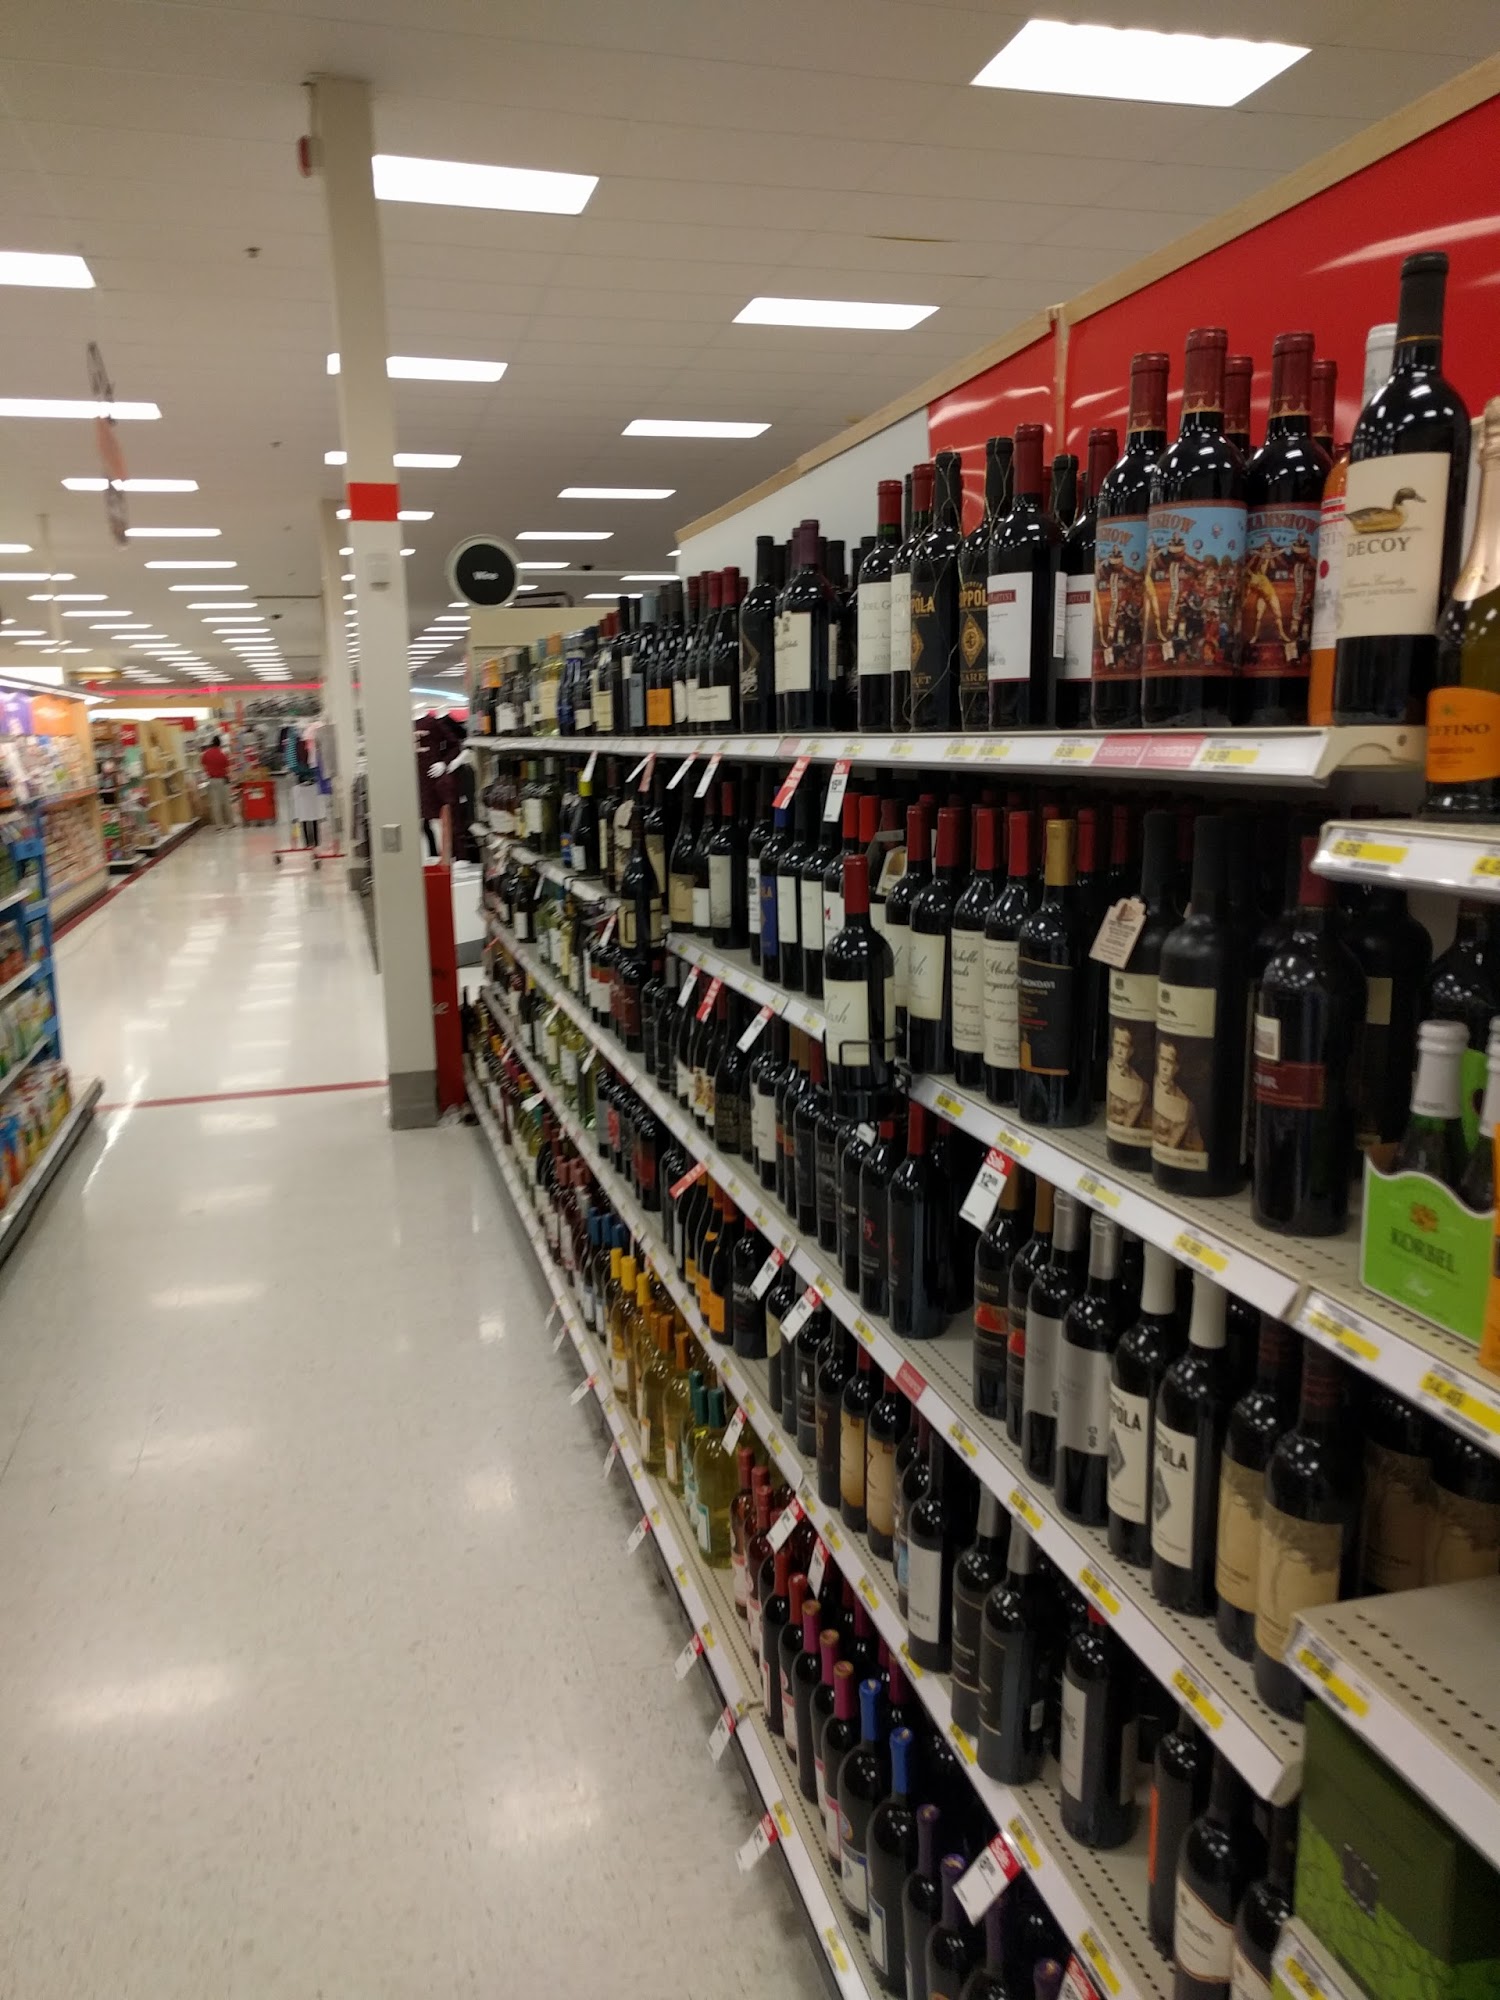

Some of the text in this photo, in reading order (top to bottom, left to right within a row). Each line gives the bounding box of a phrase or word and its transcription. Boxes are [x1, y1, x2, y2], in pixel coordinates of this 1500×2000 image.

[1347, 537, 1411, 558] DECOY
[472, 570, 499, 580] Wine
[1148, 744, 1198, 759] clearance
[1390, 1226, 1455, 1274] KORBEL
